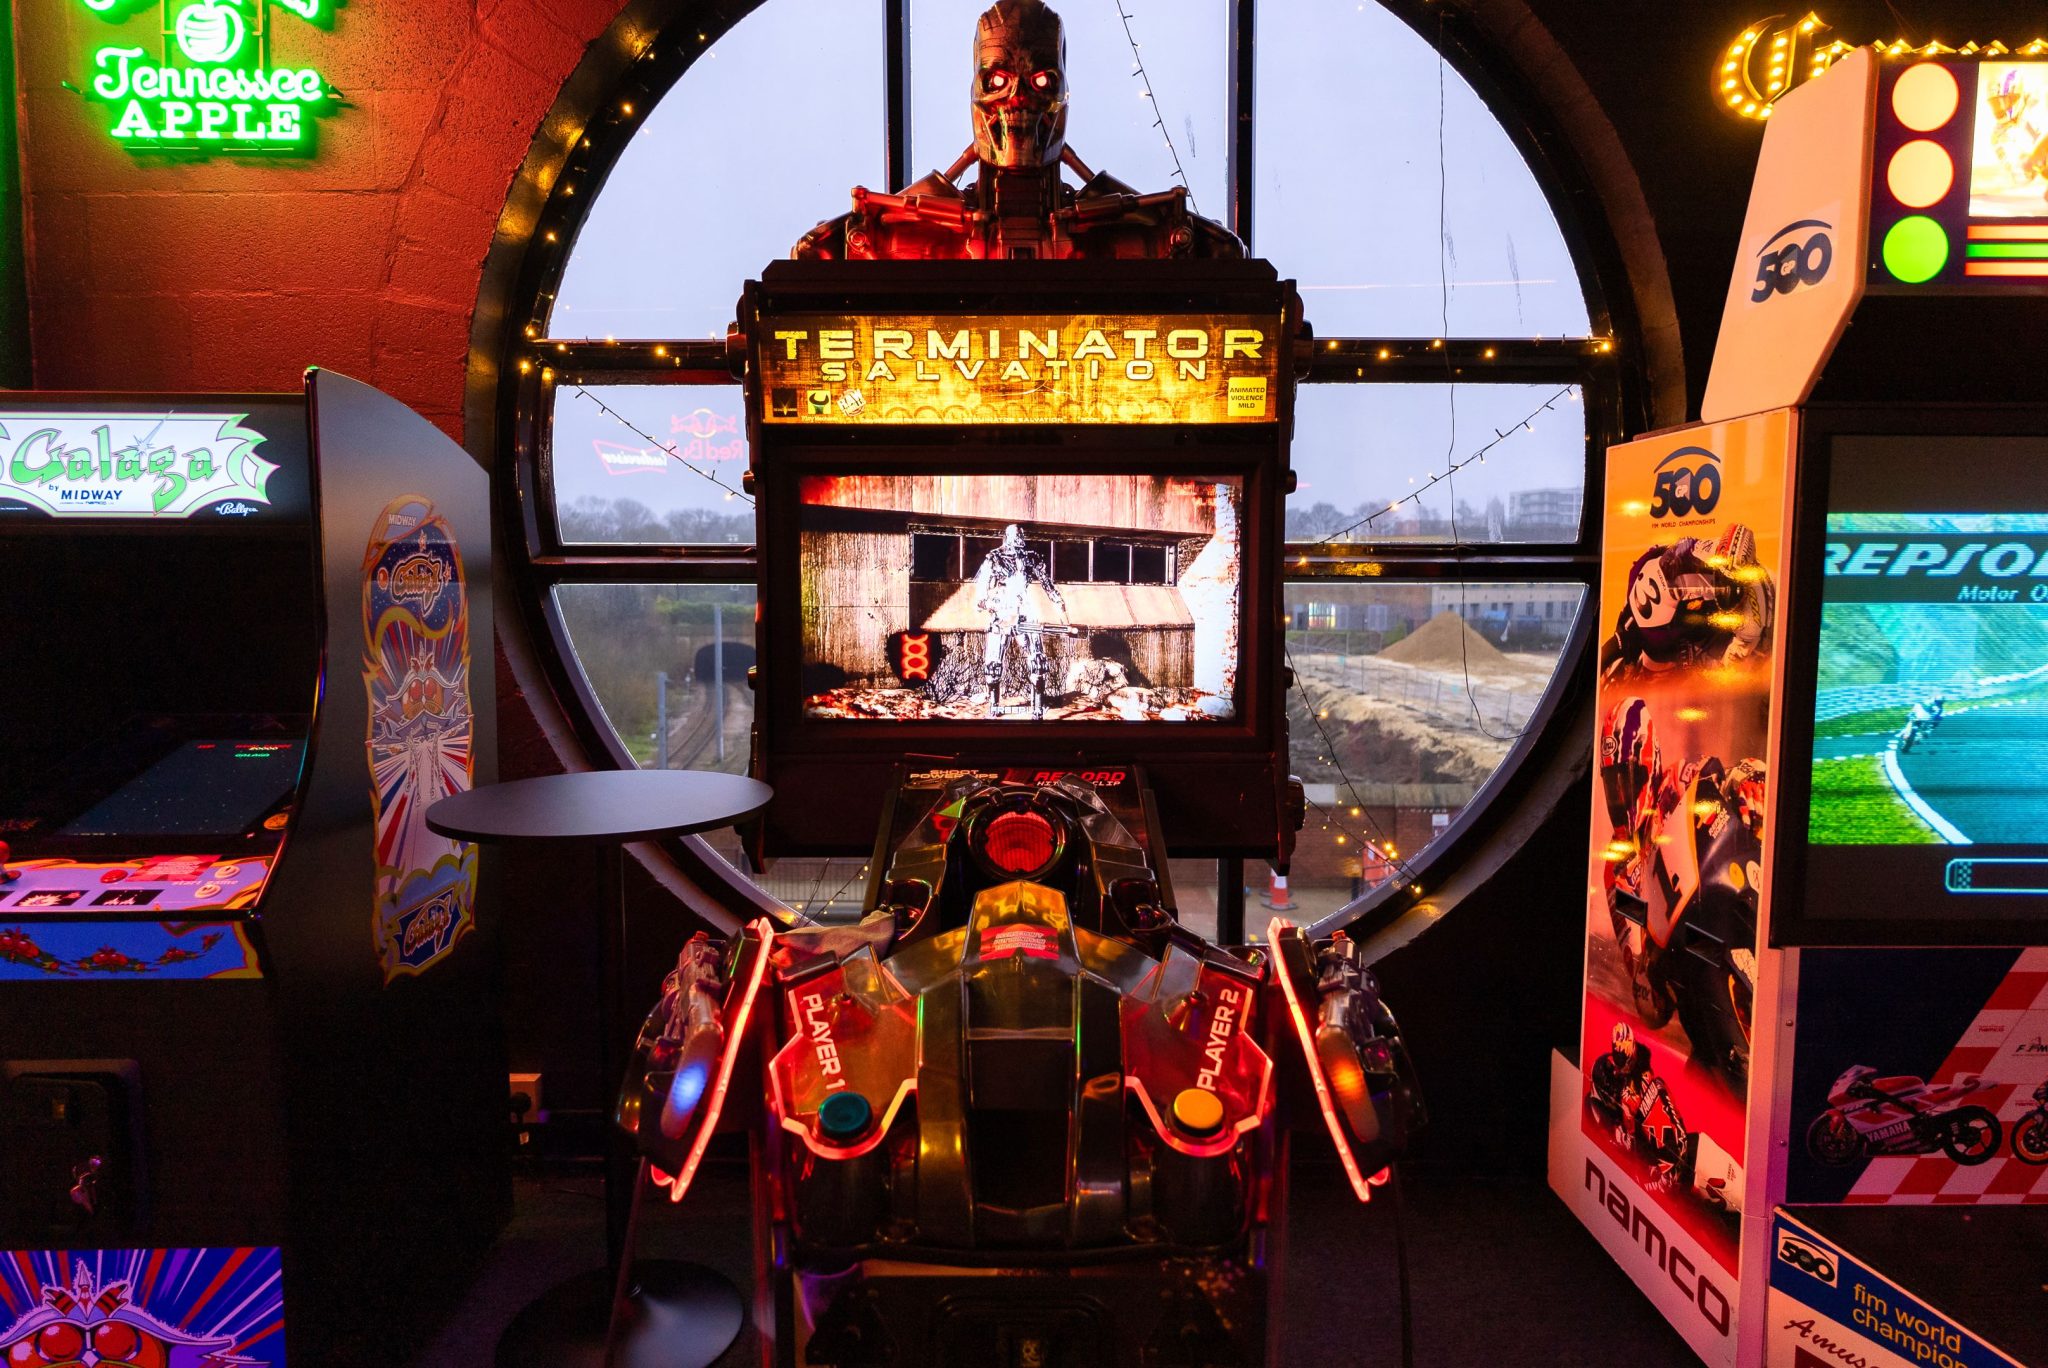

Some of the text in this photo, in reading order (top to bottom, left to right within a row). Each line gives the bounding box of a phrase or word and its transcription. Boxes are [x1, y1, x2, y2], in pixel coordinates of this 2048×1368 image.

[93, 46, 323, 100] Tennessee
[110, 99, 301, 140] APPLE
[1750, 232, 1833, 304] 500
[774, 328, 1265, 361] TERMINATOR
[820, 360, 1206, 383] SALVATION
[9, 424, 222, 517] Galaga
[48, 484, 123, 500] by MIDWAY
[1649, 463, 1722, 519] 500
[388, 514, 417, 527] MIDWAY
[1957, 585, 2019, 601] Motor
[1033, 771, 1127, 781] REOAD
[802, 993, 846, 1090] PLAYER 1
[1196, 988, 1240, 1092] PLAYER 2
[1866, 1121, 1911, 1142] YAMAHA
[1584, 1156, 1731, 1338] namco
[1852, 1283, 1962, 1354] fim world
[1783, 1319, 1881, 1368] Amus
